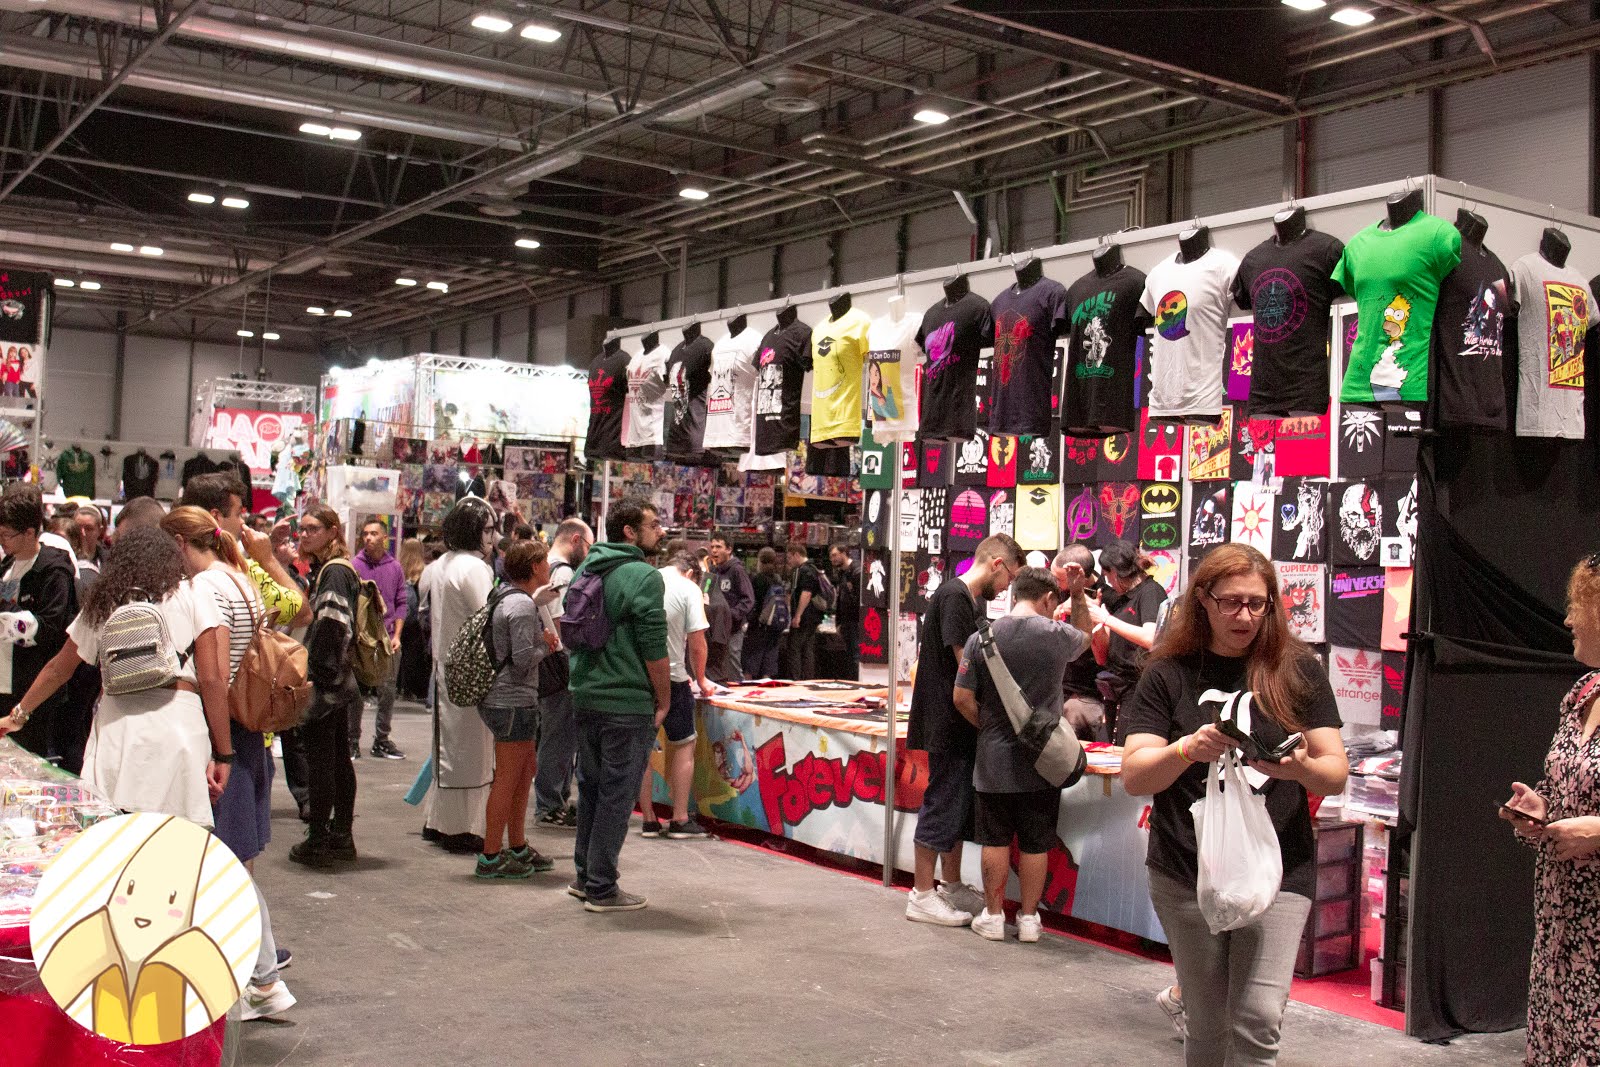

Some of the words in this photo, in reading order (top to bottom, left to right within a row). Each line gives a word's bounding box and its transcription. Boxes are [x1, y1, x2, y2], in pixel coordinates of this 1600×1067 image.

[1280, 564, 1319, 573] CUPHEAD
[1332, 575, 1385, 593] UNIVERSE
[1336, 687, 1382, 702] strange
